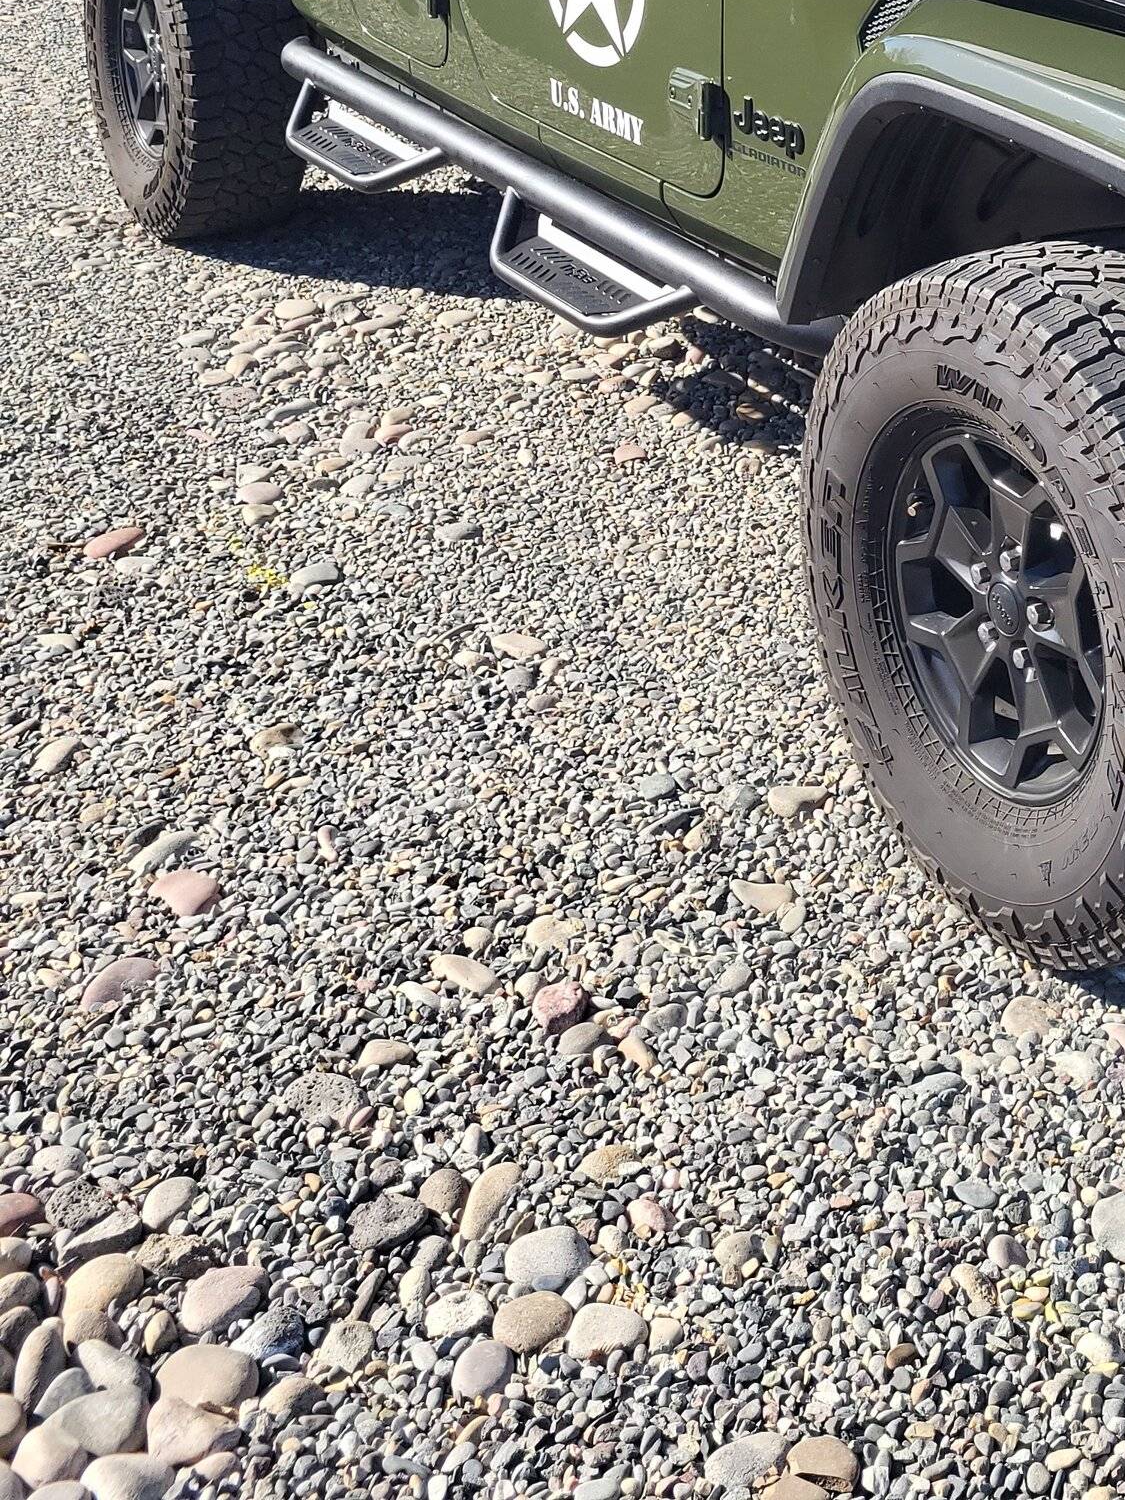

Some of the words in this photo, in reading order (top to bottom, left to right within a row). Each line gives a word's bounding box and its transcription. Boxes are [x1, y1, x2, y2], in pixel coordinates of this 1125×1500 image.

[549, 77, 585, 120] U.S.
[589, 97, 644, 146] ARMY
[733, 95, 806, 160] Jeep
[731, 140, 807, 179] GLADIATOR
